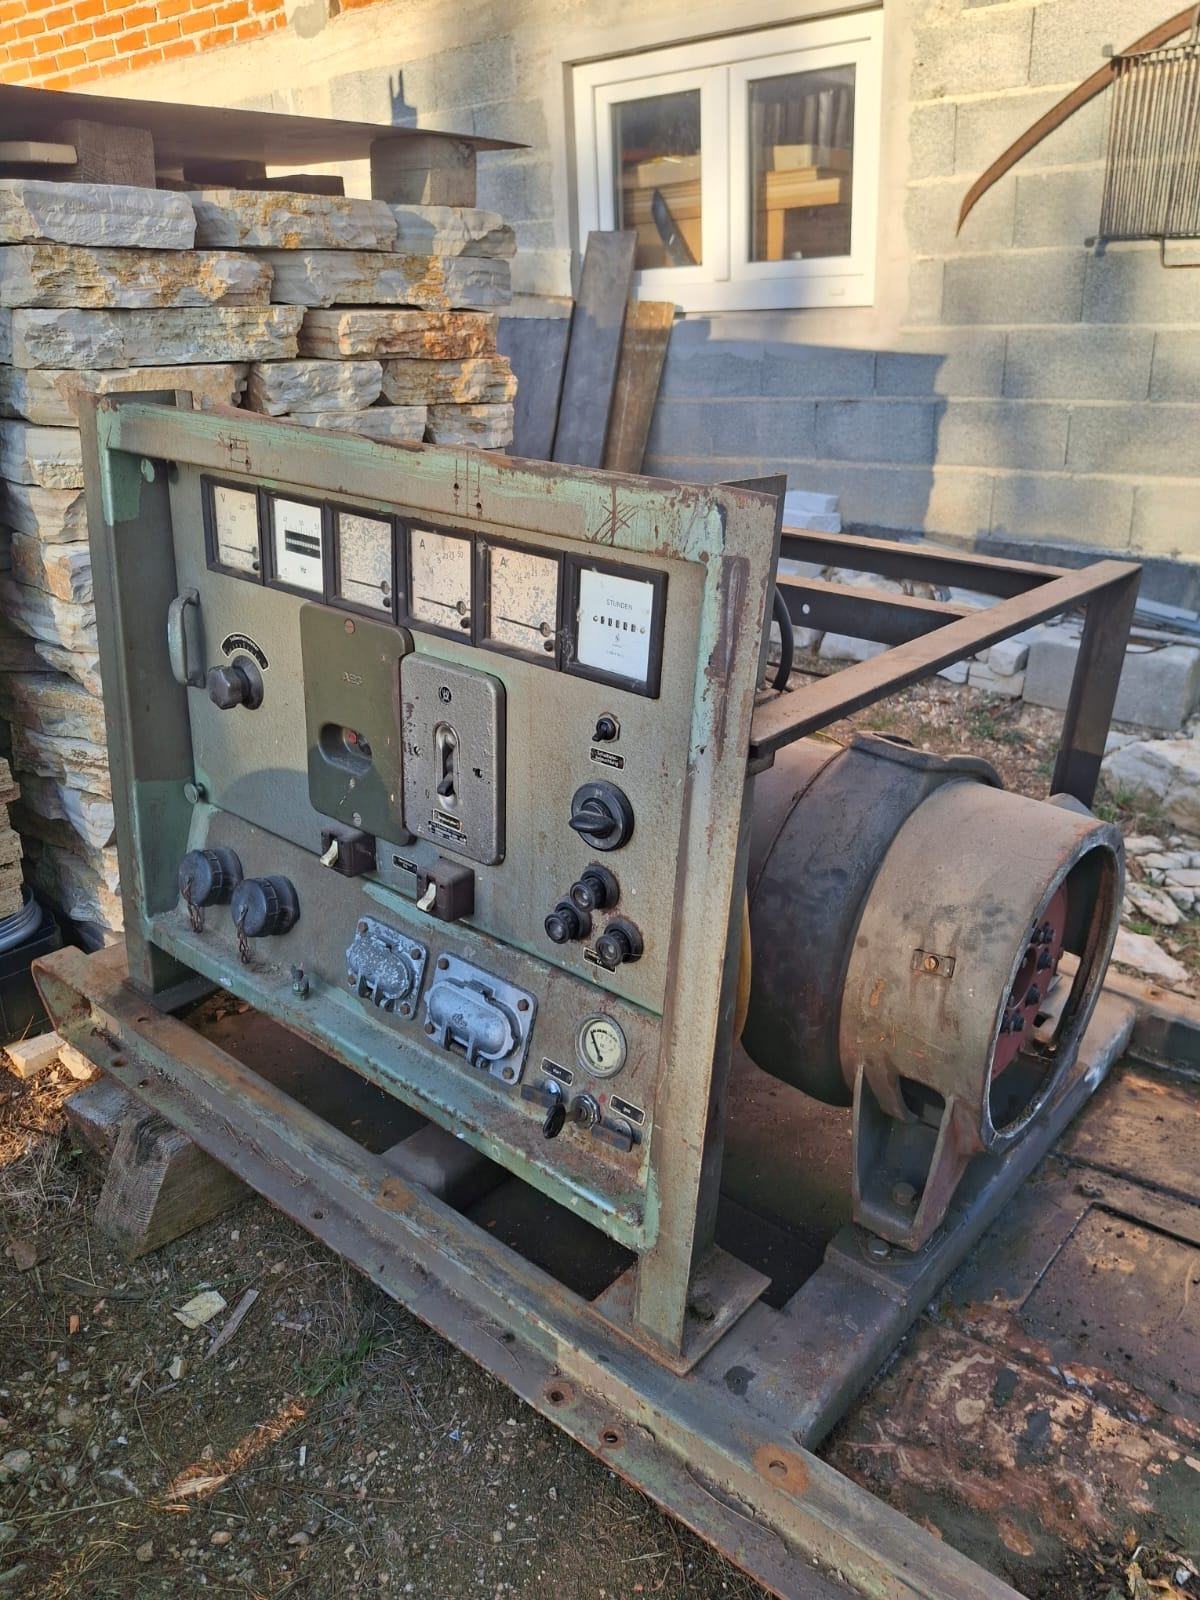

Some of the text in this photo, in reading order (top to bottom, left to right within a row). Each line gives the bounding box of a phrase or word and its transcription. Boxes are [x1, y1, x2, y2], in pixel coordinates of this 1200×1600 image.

[220, 494, 226, 503] V
[419, 538, 426, 550] A
[606, 599, 633, 611] STUNDEN
